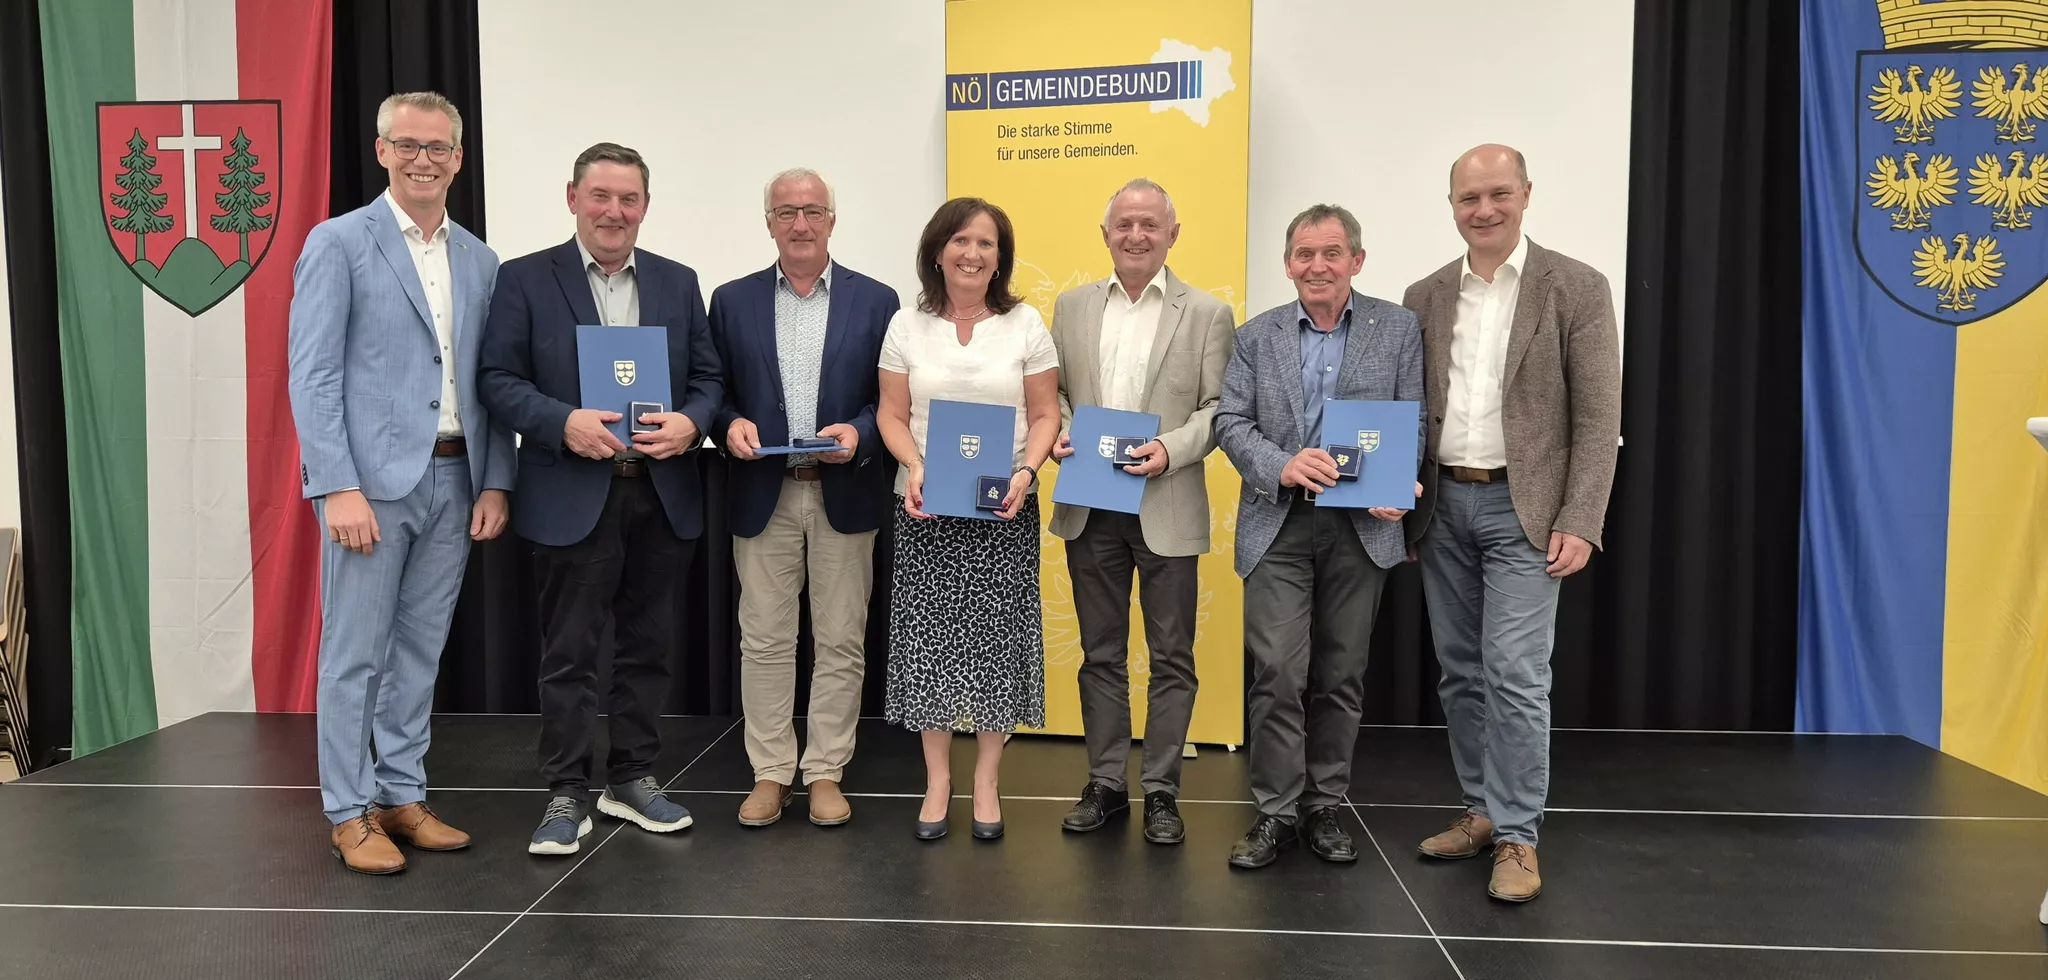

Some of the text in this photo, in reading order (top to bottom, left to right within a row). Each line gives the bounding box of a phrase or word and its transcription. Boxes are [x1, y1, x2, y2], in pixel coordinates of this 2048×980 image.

[952, 70, 1172, 104] NÖ GEMEINDEBUND
[997, 120, 1113, 139] Die starke Stimme
[997, 142, 1139, 161] für unsere Gemeinden.
